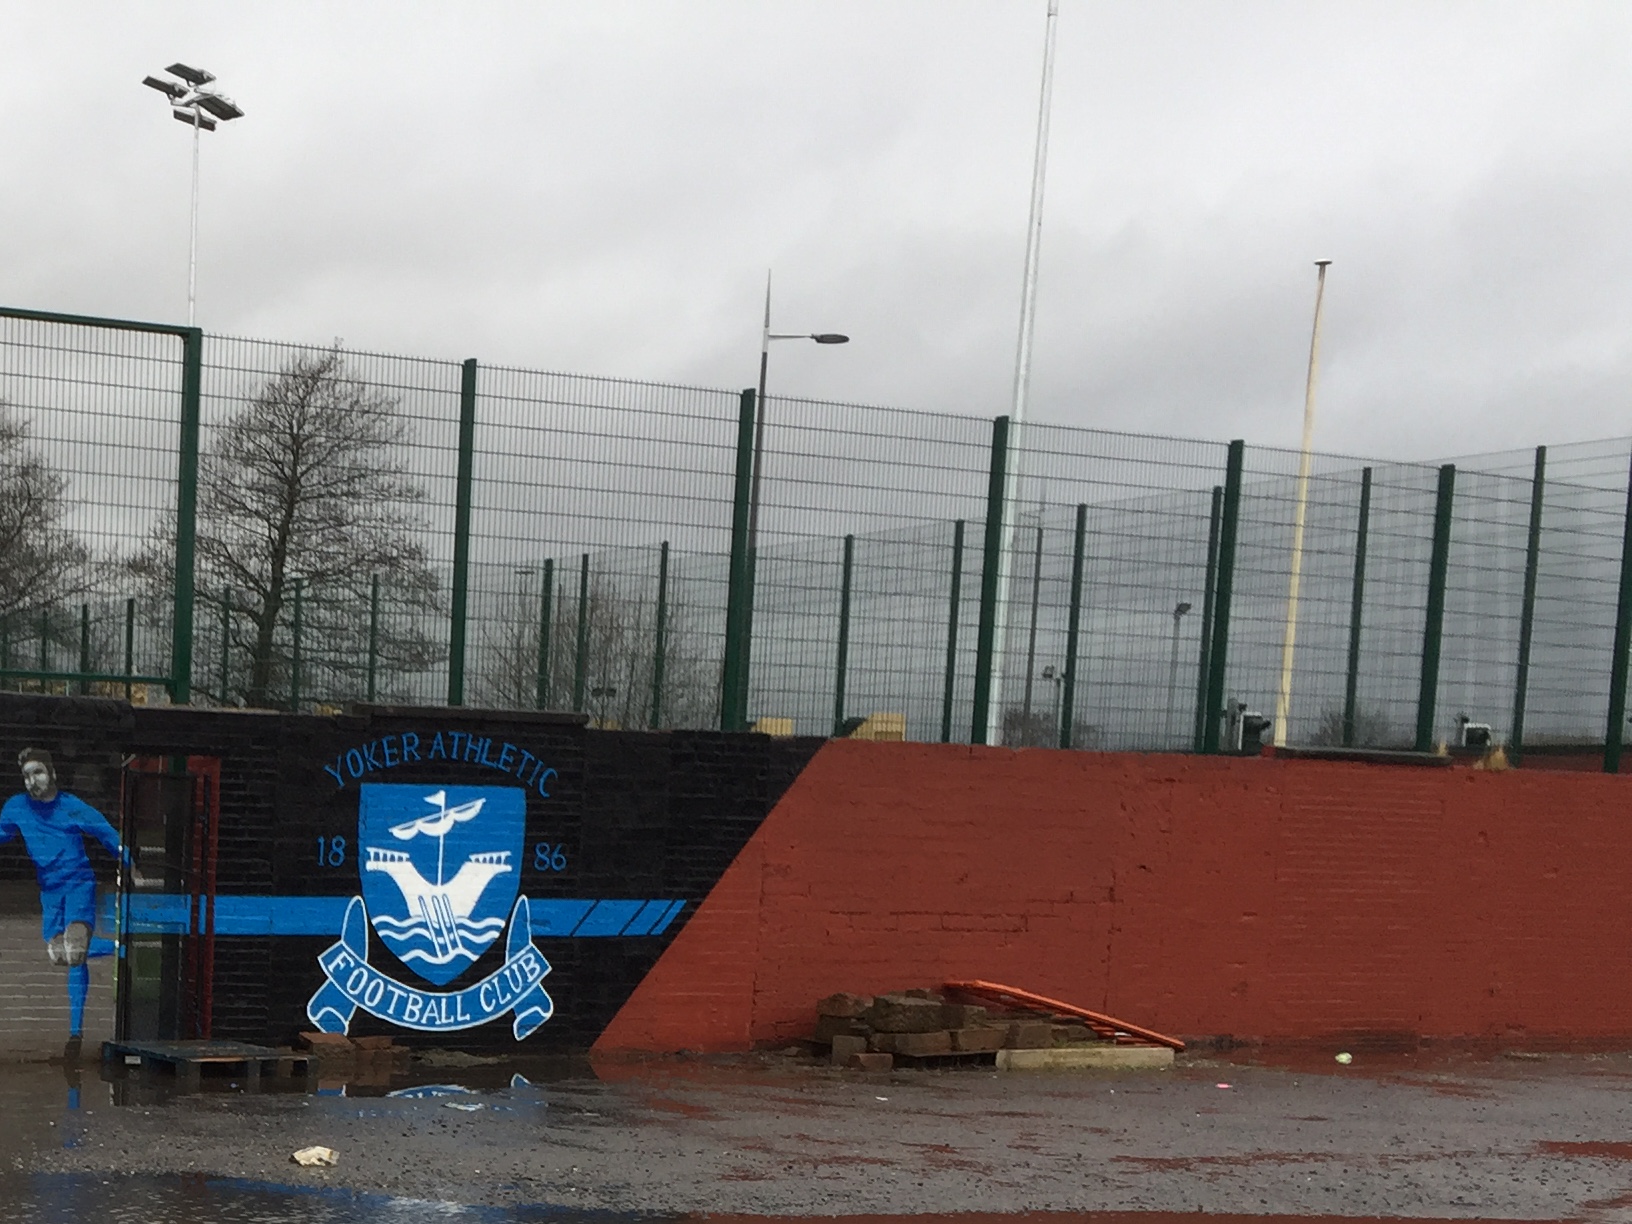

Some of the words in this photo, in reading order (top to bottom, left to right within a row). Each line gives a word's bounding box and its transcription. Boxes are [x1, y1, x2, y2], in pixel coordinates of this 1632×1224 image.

[324, 731, 421, 788] YOKER
[429, 730, 559, 798] ATHLETIC
[317, 835, 346, 867] 18
[533, 841, 567, 872] 86
[327, 951, 471, 1025] FOOTBALL
[479, 951, 542, 1013] CLUB
